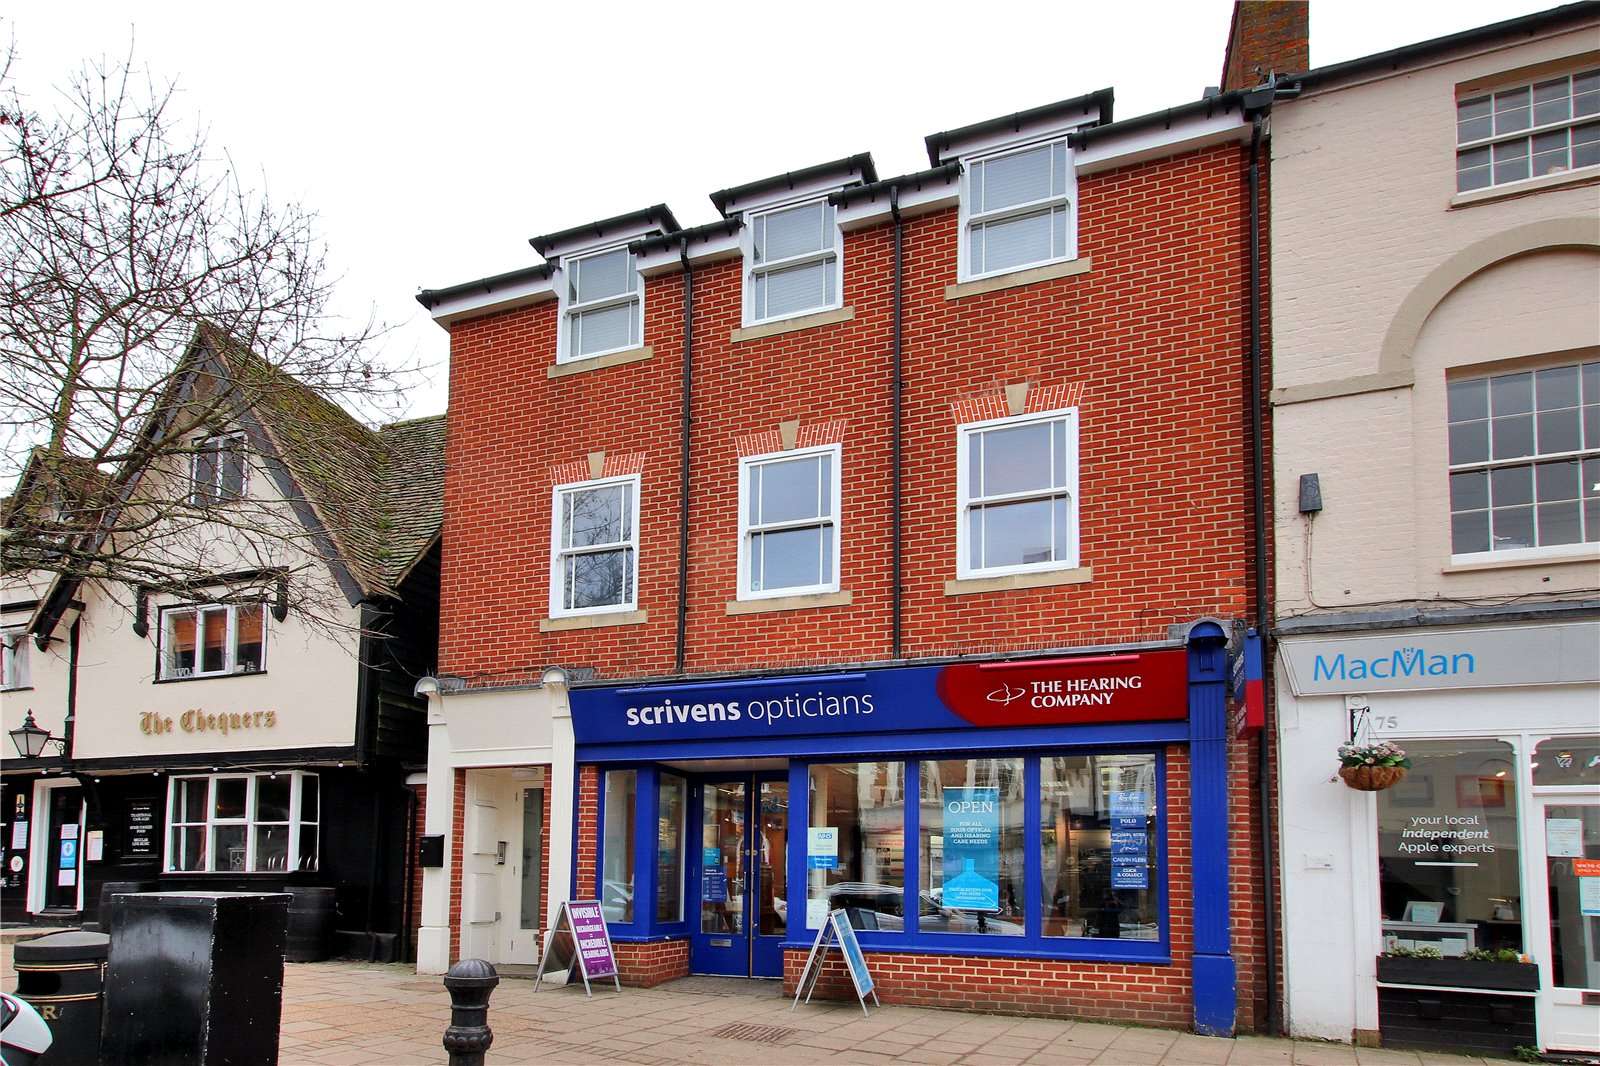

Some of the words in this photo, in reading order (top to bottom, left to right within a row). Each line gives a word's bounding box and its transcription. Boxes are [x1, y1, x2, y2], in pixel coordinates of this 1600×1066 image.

[1313, 648, 1475, 681] MacMan
[1031, 681, 1062, 694] THE
[1067, 676, 1142, 692] HEARING
[1030, 693, 1114, 708] COMPANY
[627, 700, 741, 726] scrivens
[748, 692, 874, 725] opticians
[139, 711, 173, 736] The
[180, 708, 277, 736] Chequers
[1375, 716, 1398, 730] 75
[948, 801, 994, 814] OPEN
[1411, 816, 1442, 826] your
[1445, 816, 1480, 825] local
[1402, 828, 1490, 840] independent
[1398, 842, 1439, 854] Apple
[1442, 844, 1496, 854] experts
[571, 906, 600, 919] INVISIBLE
